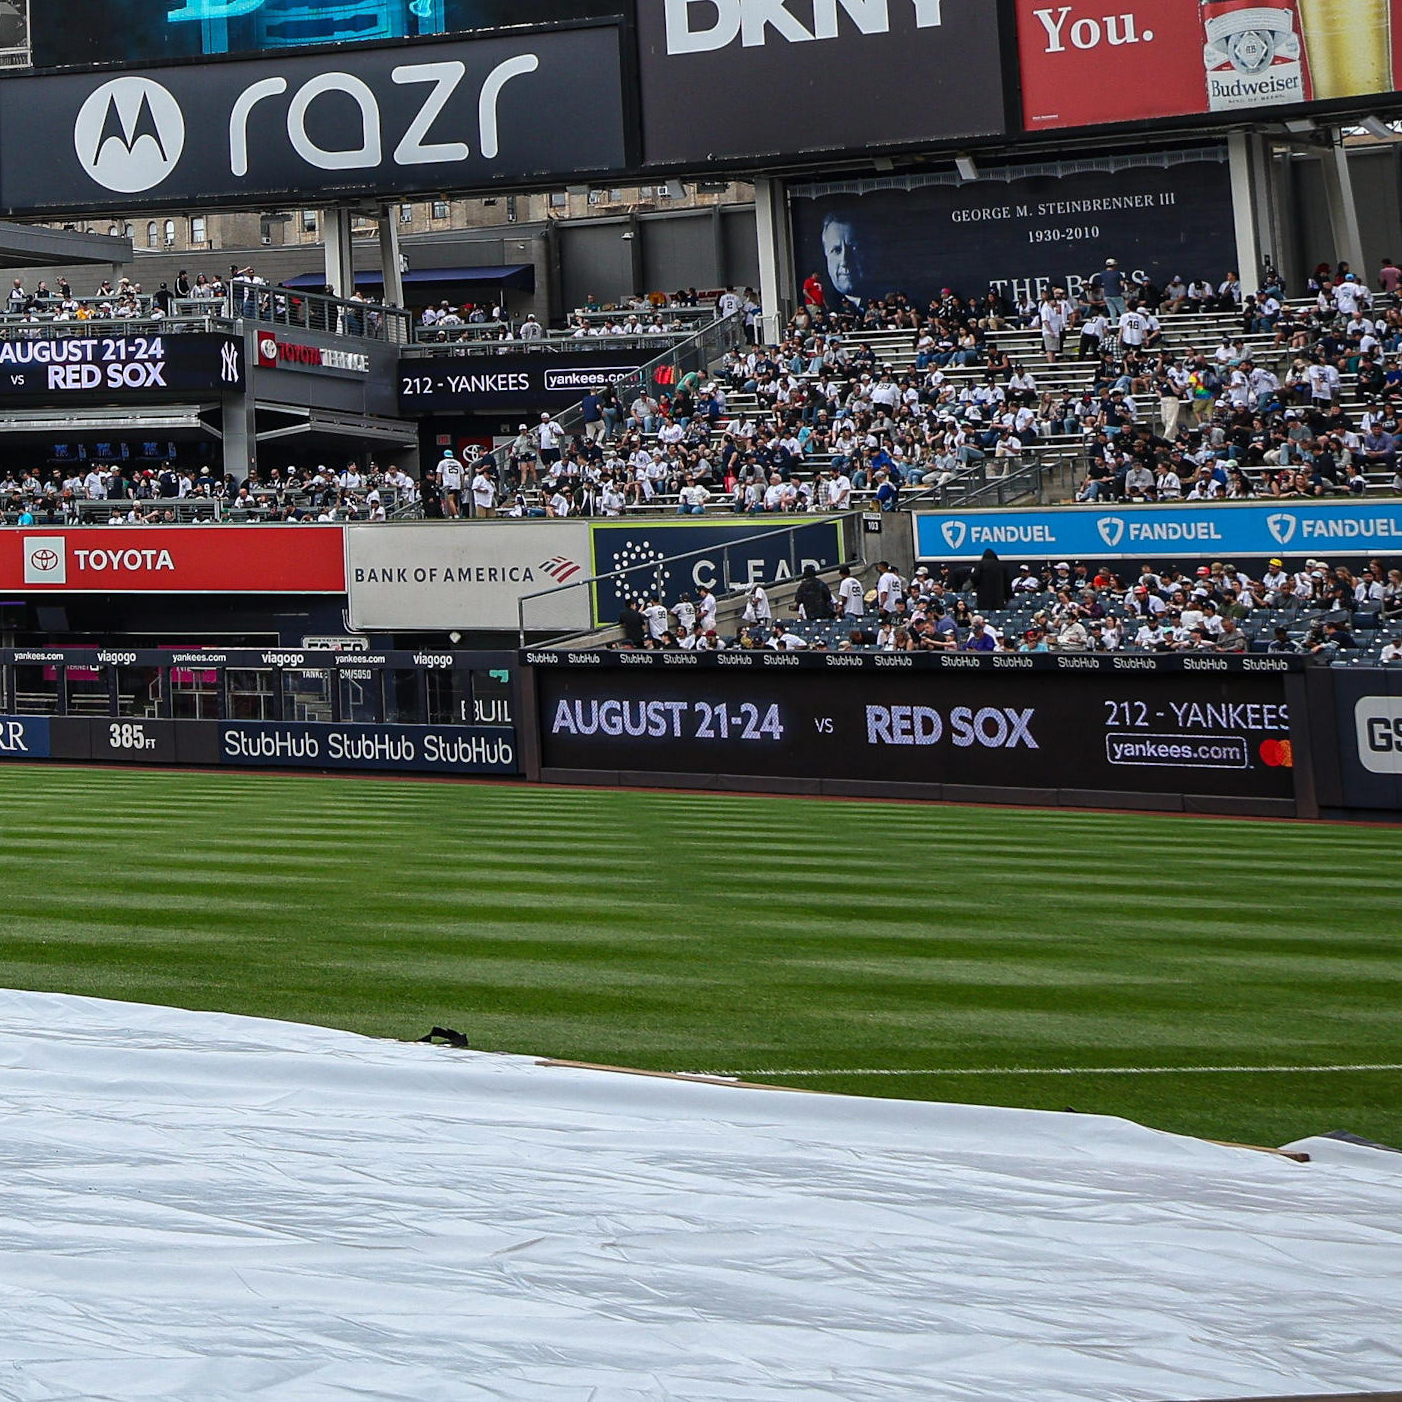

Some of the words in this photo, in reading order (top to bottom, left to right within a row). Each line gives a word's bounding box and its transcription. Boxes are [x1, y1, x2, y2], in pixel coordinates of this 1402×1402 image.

[1033, 4, 1154, 54] You.
[1211, 76, 1298, 99] Budweiser
[230, 54, 539, 177] razr
[951, 206, 1011, 223] GEORGE
[1016, 205, 1033, 218] M.
[1038, 194, 1154, 216] STEINBRENNER
[1159, 192, 1176, 205] III
[1028, 225, 1100, 243] 1930-2010
[989, 276, 1050, 304] THE
[101, 337, 165, 360] 21-24
[10, 374, 25, 386] VS
[47, 364, 102, 390] RED
[106, 361, 167, 388] SOX
[402, 377, 433, 395] 212
[446, 373, 529, 393] YANKEES
[867, 521, 879, 531] 103
[971, 525, 1056, 543] FANDUEL
[1130, 522, 1222, 540] FANDUEL
[73, 549, 175, 571] TOYOTA
[355, 567, 407, 583] BANK
[413, 567, 438, 583] OF
[443, 566, 534, 583] AMERICA
[620, 653, 653, 665] StubHub
[993, 656, 1033, 668] StubHub
[551, 699, 688, 738] AUGUST
[695, 702, 784, 740] 21-24
[1104, 700, 1150, 727] 212
[1169, 701, 1289, 730] YANKEES
[109, 723, 144, 750] 385
[145, 738, 156, 750] FT
[224, 730, 319, 758] StubHub
[424, 734, 513, 765] StubHub
[1112, 740, 1241, 760] yankees.com
